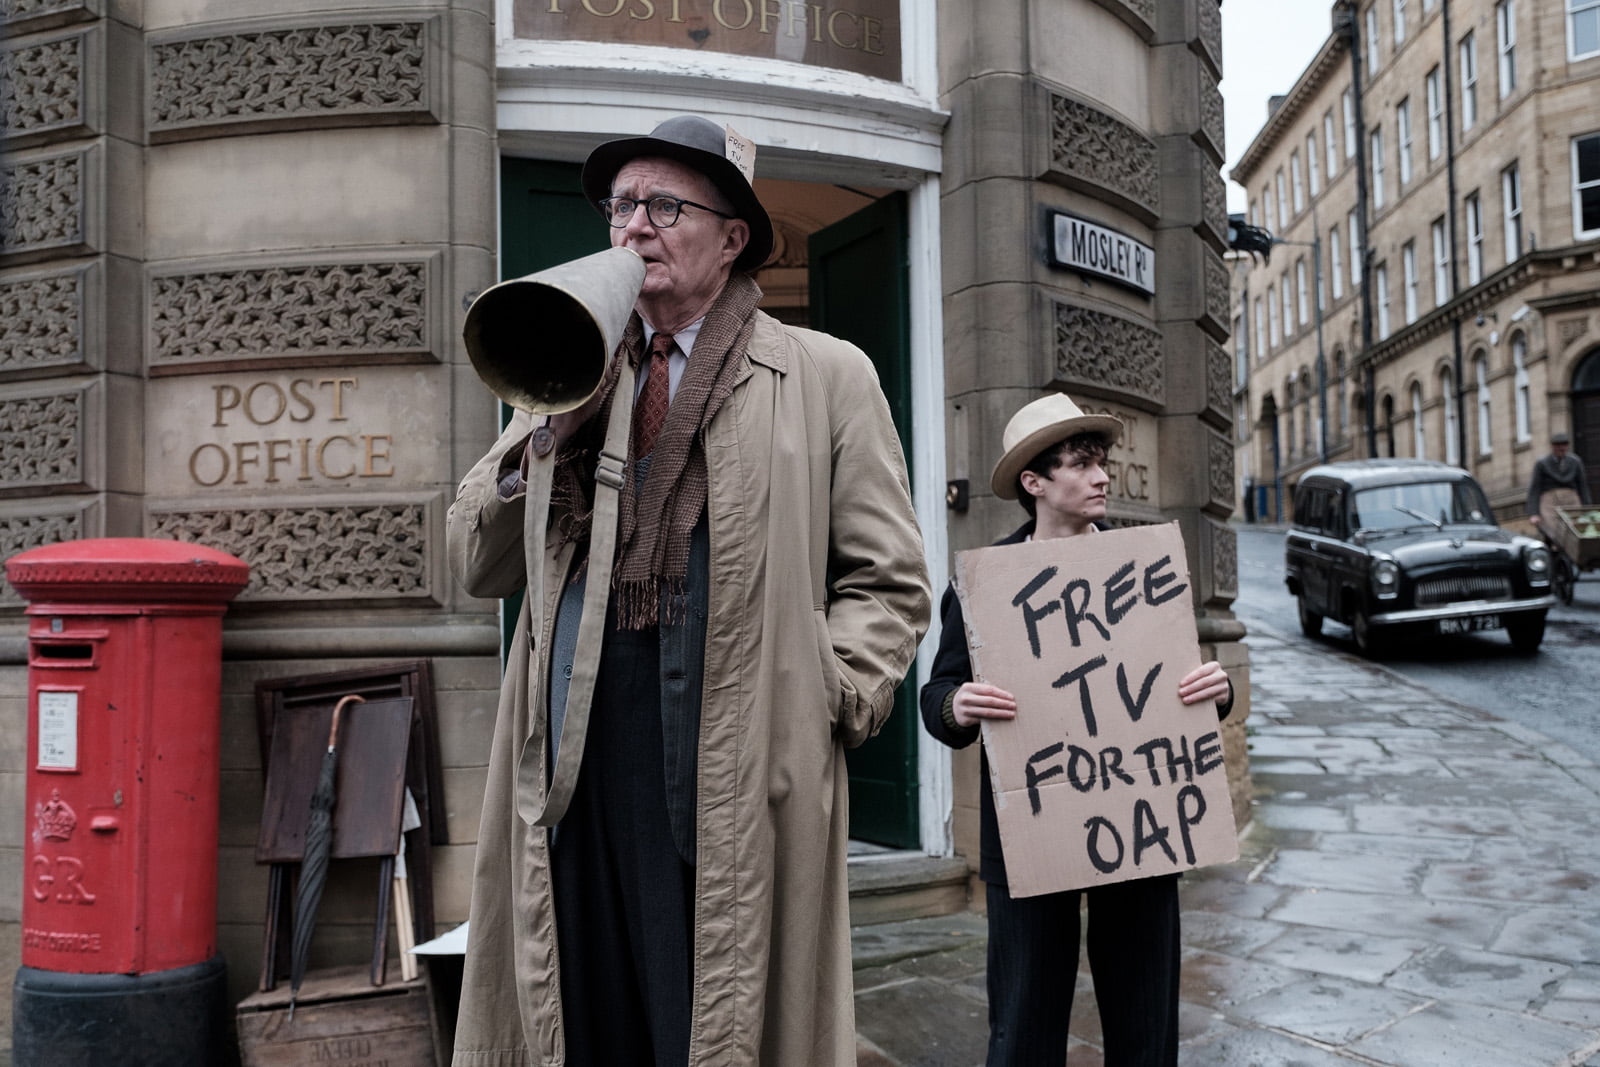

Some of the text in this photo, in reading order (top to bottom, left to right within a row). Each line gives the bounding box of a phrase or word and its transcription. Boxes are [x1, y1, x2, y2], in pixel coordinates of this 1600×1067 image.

[711, 0, 885, 56] OFFICE
[1071, 221, 1131, 279] MOSLEY
[211, 376, 359, 428] POST
[188, 434, 396, 488] OFFICE
[1106, 459, 1149, 501] FICE
[1012, 555, 1189, 659] FREE
[1052, 654, 1164, 738] TV
[1025, 731, 1225, 817] FOR THE
[1084, 784, 1207, 874] OAP
